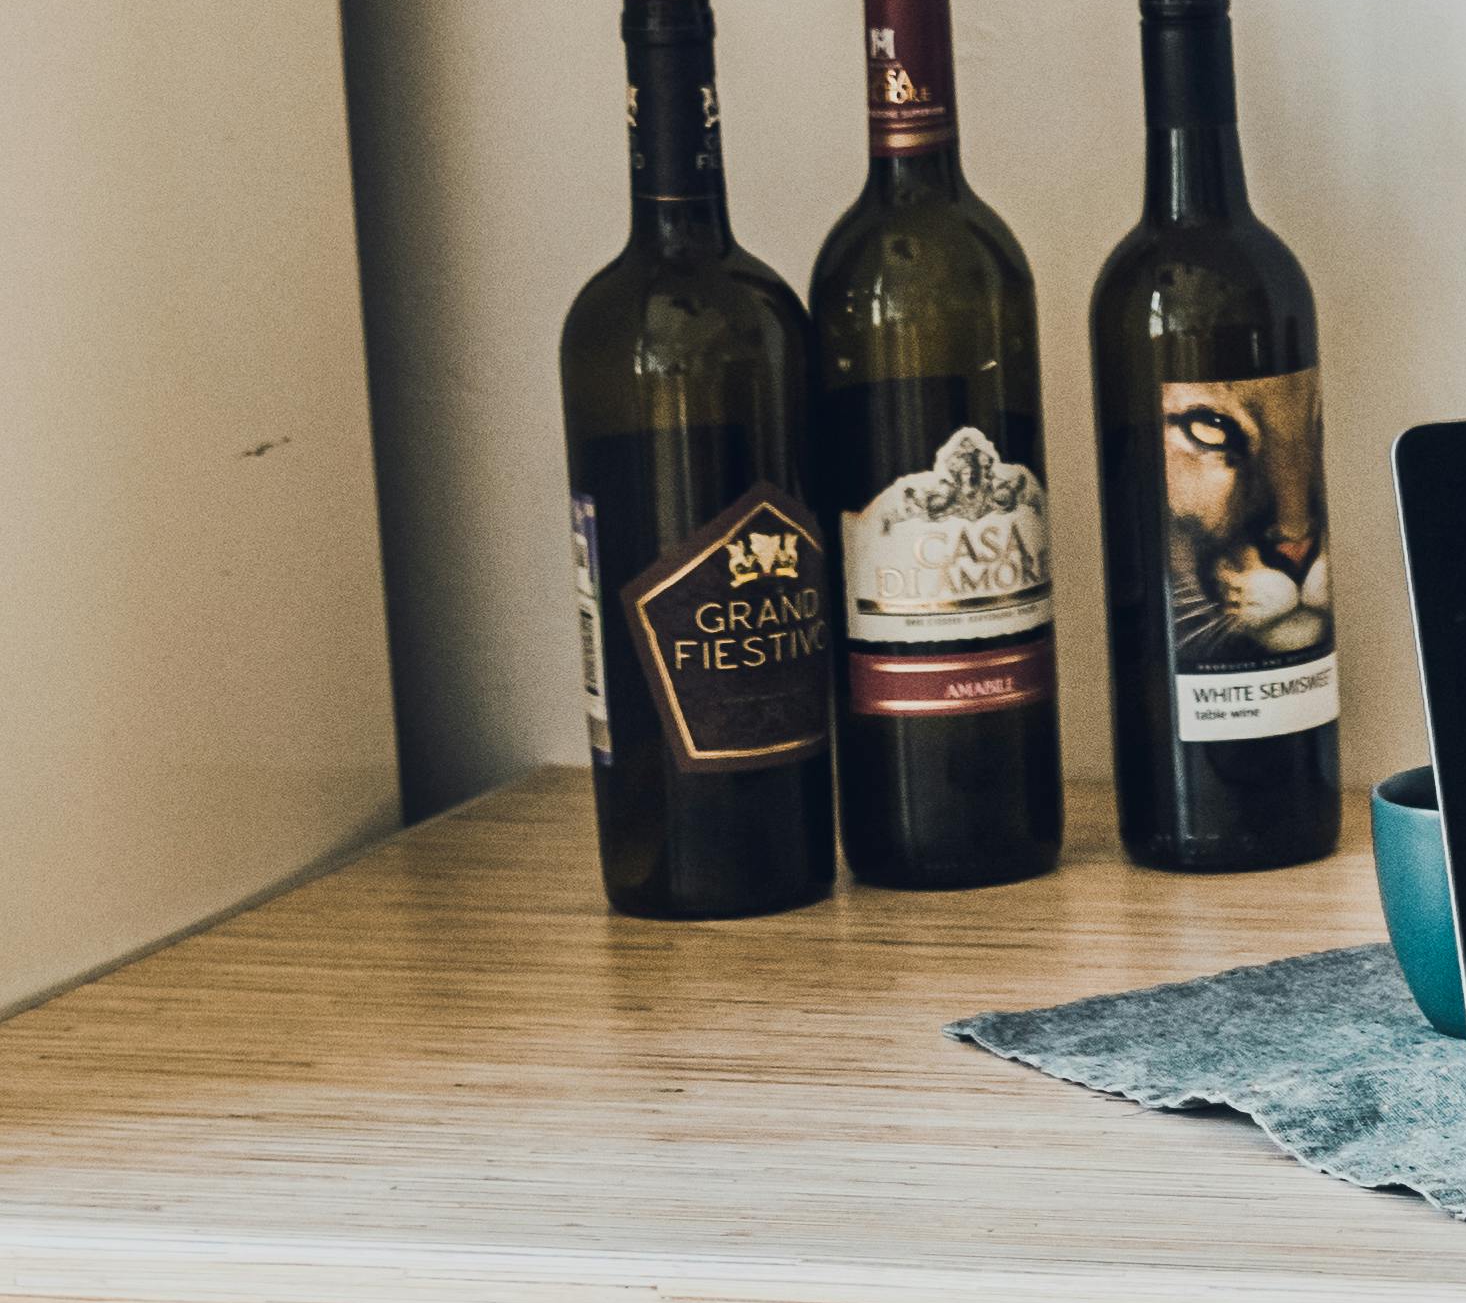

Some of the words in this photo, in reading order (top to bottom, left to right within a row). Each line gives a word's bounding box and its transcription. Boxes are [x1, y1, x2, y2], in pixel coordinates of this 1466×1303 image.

[913, 522, 1037, 569] CASA
[876, 565, 922, 598] DI
[695, 588, 820, 634] GRAND
[1192, 685, 1254, 703] WHITE
[1195, 707, 1227, 721] table
[1231, 707, 1261, 718] wine
